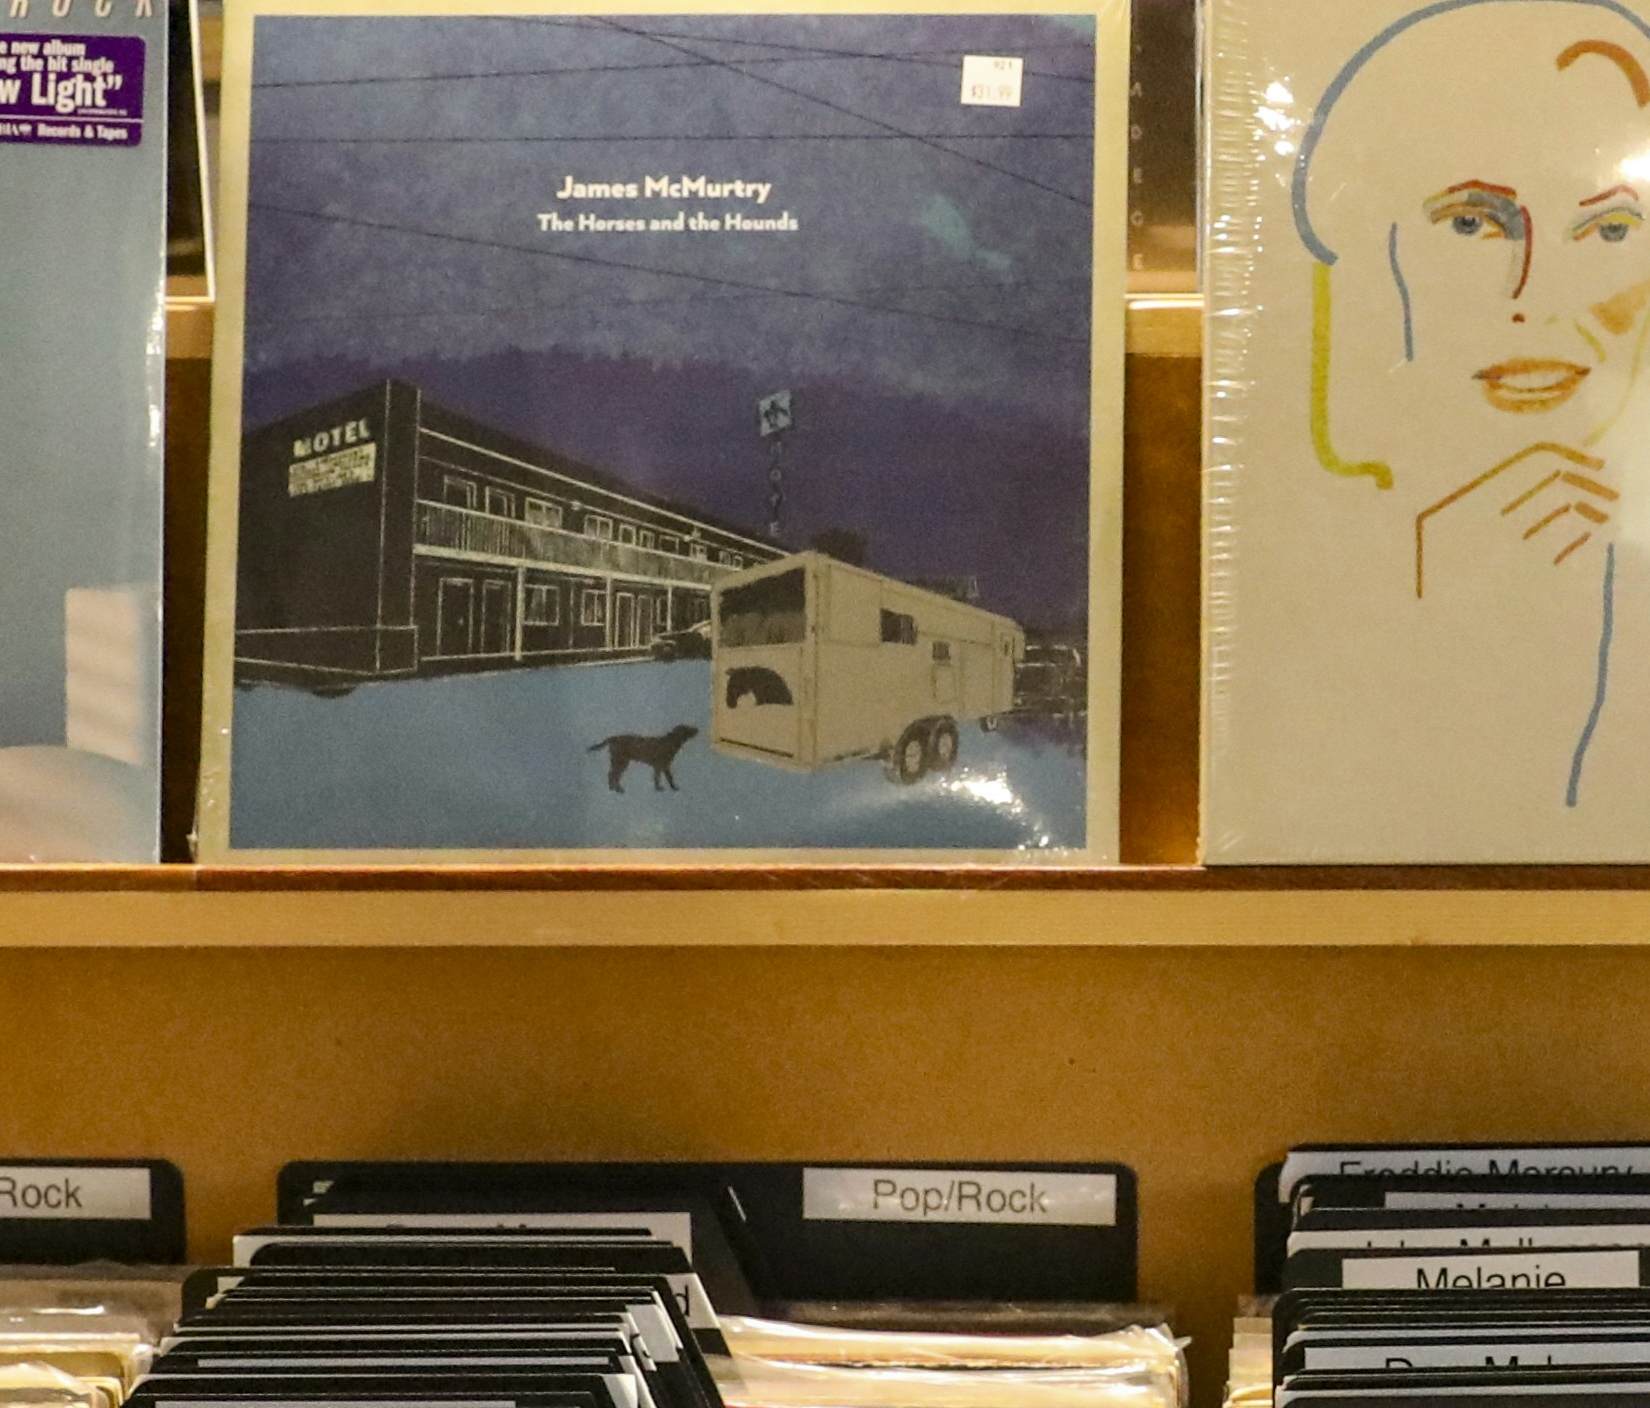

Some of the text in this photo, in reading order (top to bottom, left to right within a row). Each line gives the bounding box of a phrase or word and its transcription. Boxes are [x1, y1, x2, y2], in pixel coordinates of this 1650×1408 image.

[11, 41, 39, 55] new
[42, 38, 86, 56] album
[21, 55, 45, 72] the
[48, 56, 68, 72] hit
[71, 57, 115, 75] single
[37, 124, 82, 139] Records
[84, 125, 95, 139] &
[97, 125, 129, 141] Tapes
[555, 174, 773, 204] James McMurtry
[537, 212, 800, 234] The Horses and the Hounds
[292, 417, 372, 459] MOTEL
[872, 1178, 1049, 1217] Pop/Rock
